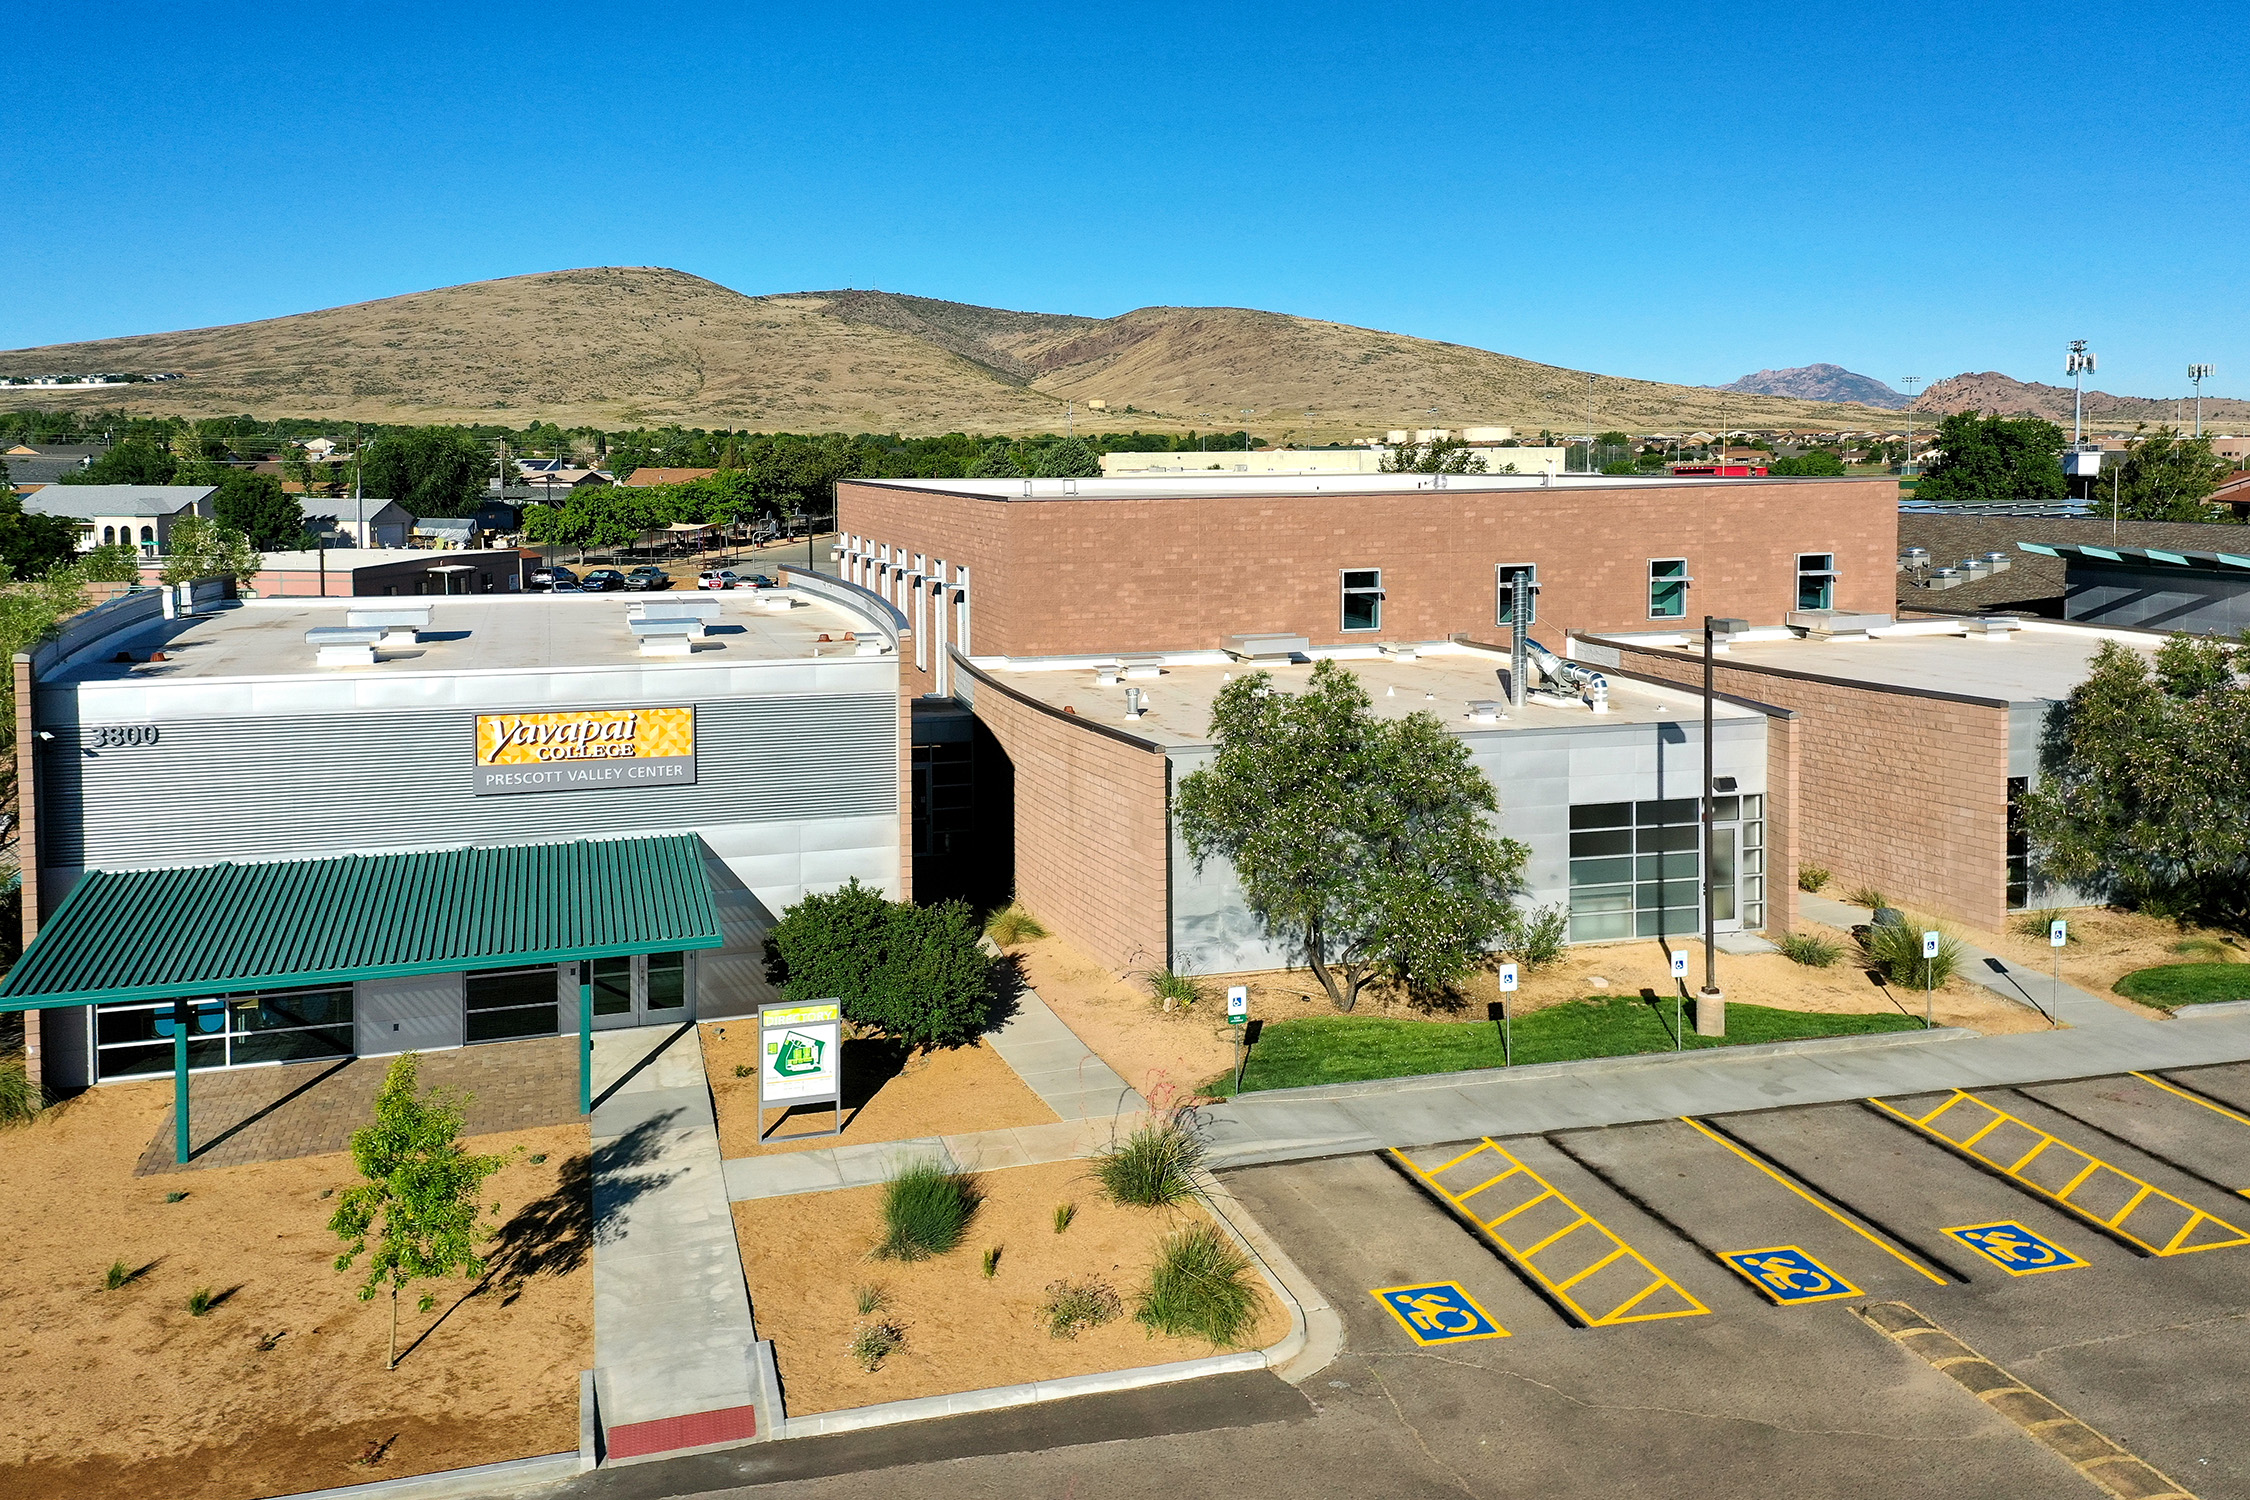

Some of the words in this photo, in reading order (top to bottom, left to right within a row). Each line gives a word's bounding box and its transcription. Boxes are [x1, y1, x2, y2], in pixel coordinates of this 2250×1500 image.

[90, 725, 158, 747] 3800
[488, 712, 637, 762] Yavapai
[536, 743, 636, 761] COLLEGE
[486, 770, 562, 786] PRESCOTT
[567, 767, 623, 782] VALLEY
[627, 764, 683, 779] CENTER
[765, 1010, 833, 1027] DIRECTORY
